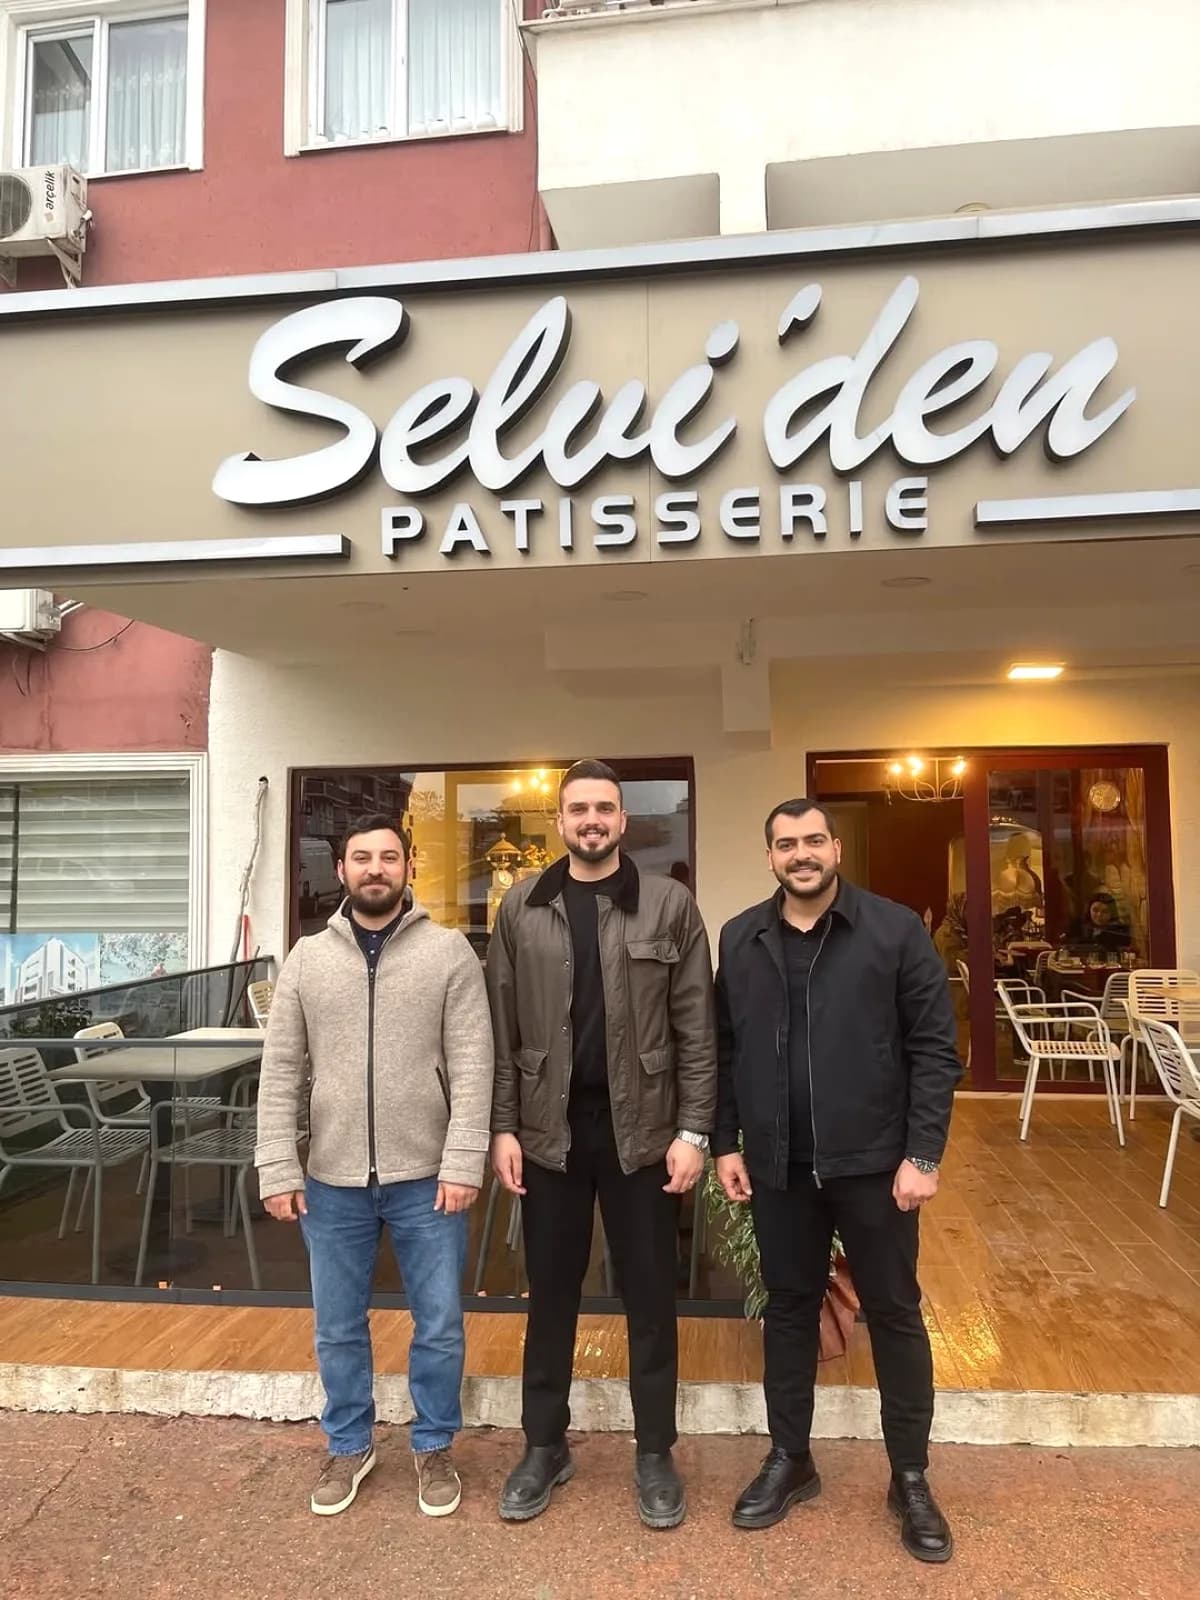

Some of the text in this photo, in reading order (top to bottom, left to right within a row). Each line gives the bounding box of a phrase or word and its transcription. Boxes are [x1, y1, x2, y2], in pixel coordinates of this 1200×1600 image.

[44, 171, 56, 211] arçelik
[212, 276, 1136, 506] Selvi'den
[381, 477, 929, 558] PATISSERIE
